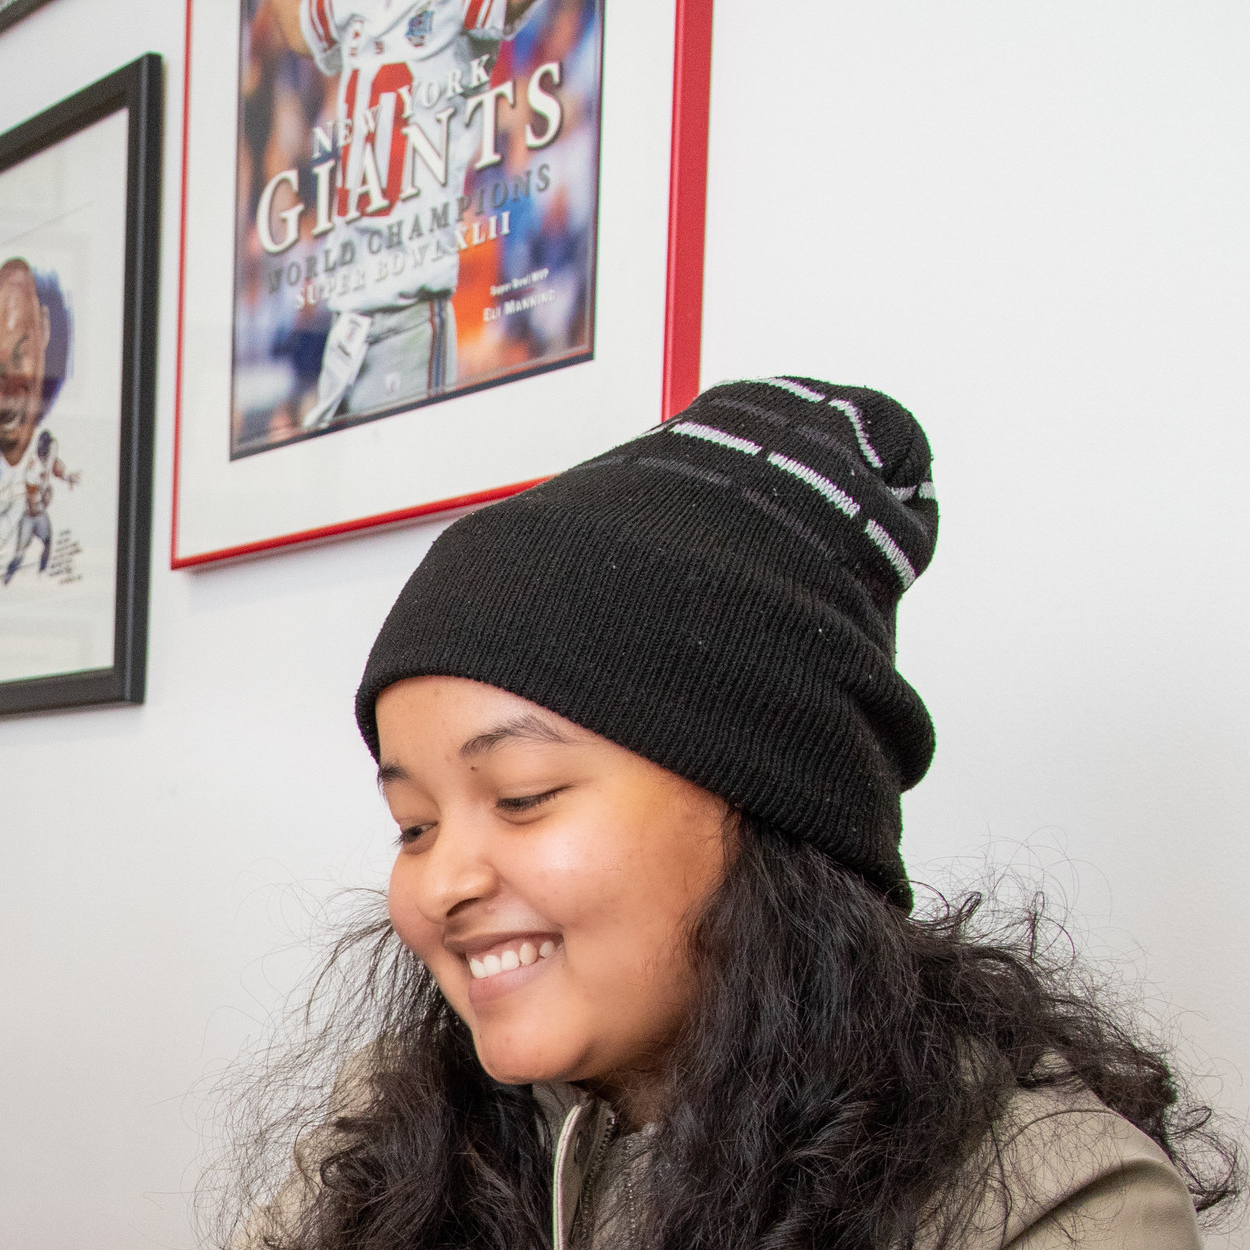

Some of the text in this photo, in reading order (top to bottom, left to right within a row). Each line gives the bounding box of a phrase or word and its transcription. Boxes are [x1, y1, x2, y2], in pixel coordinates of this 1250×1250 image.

[256, 62, 564, 254] GIANTS
[312, 54, 492, 160] NEW YORK
[266, 162, 552, 296] WORLD CHAMPIONS
[296, 268, 368, 310] SUPER
[452, 210, 512, 250] XLII
